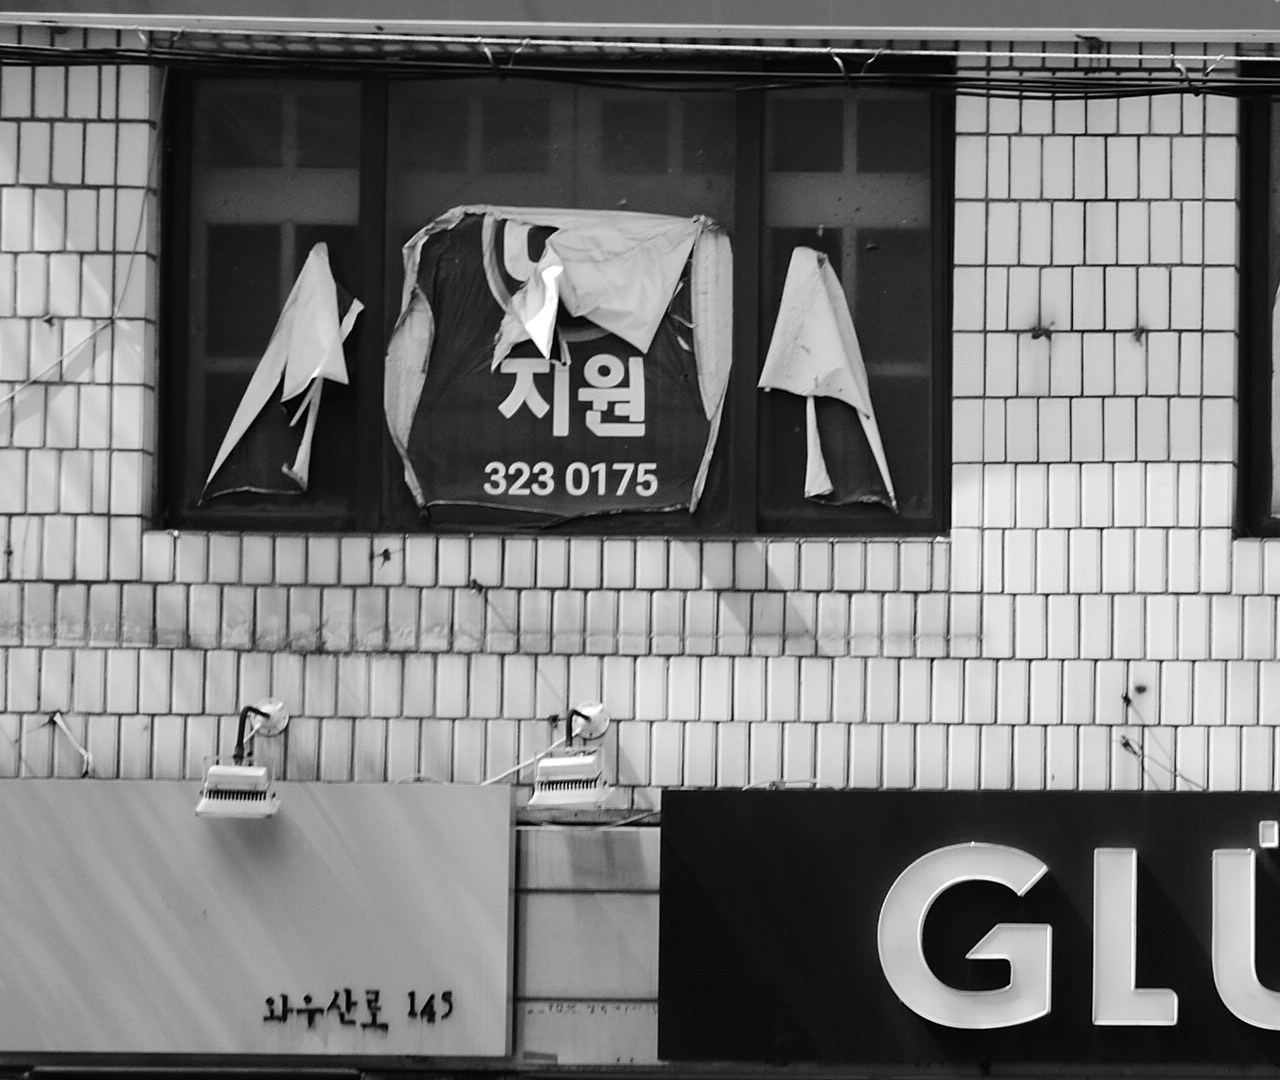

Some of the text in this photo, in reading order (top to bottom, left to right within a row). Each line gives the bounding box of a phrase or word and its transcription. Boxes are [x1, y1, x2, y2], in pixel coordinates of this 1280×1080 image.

[498, 353, 646, 438] 지원
[484, 461, 659, 497] 323 0175
[262, 988, 454, 1031] 와우산로 145
